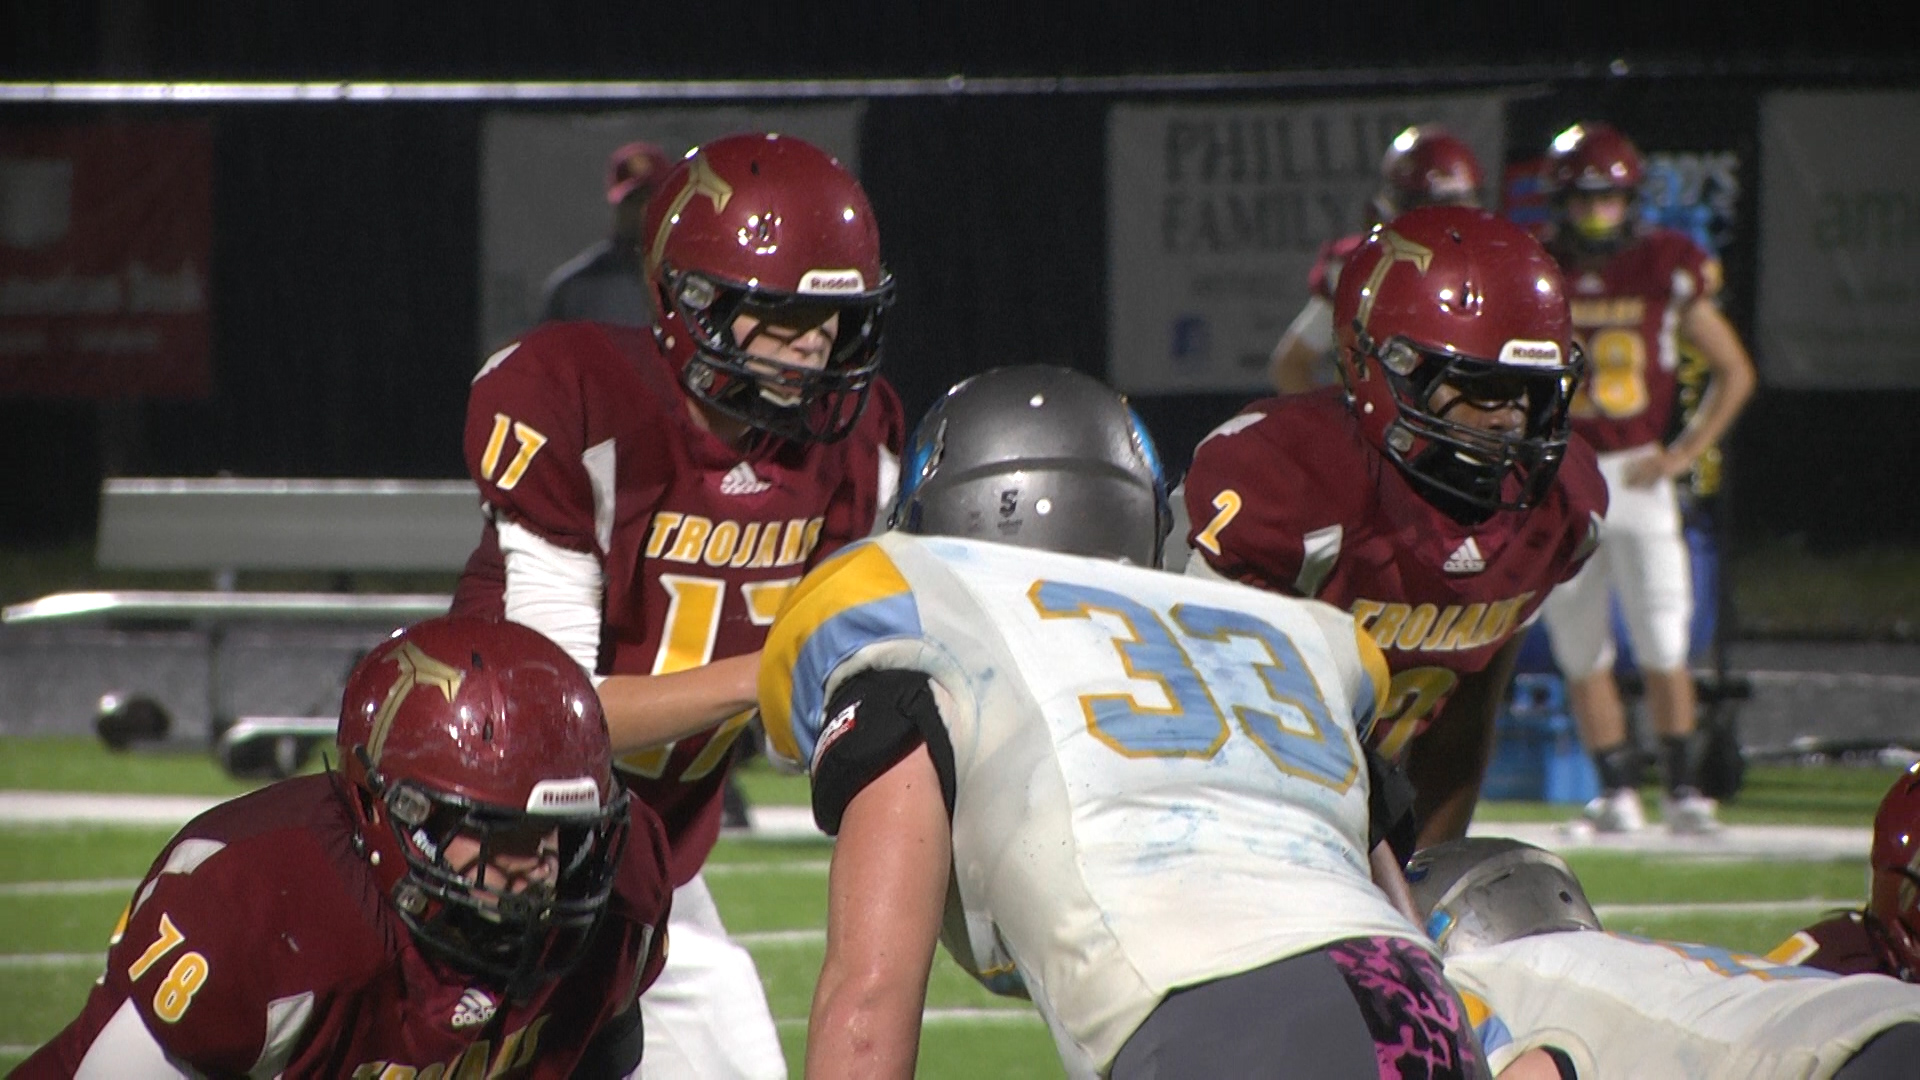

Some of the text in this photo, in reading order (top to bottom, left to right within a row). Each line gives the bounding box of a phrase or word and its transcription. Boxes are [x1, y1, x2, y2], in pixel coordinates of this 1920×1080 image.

[481, 412, 547, 490] 17
[1196, 489, 1242, 556] 2
[1026, 579, 1358, 796] 33
[128, 912, 209, 1024] 78
